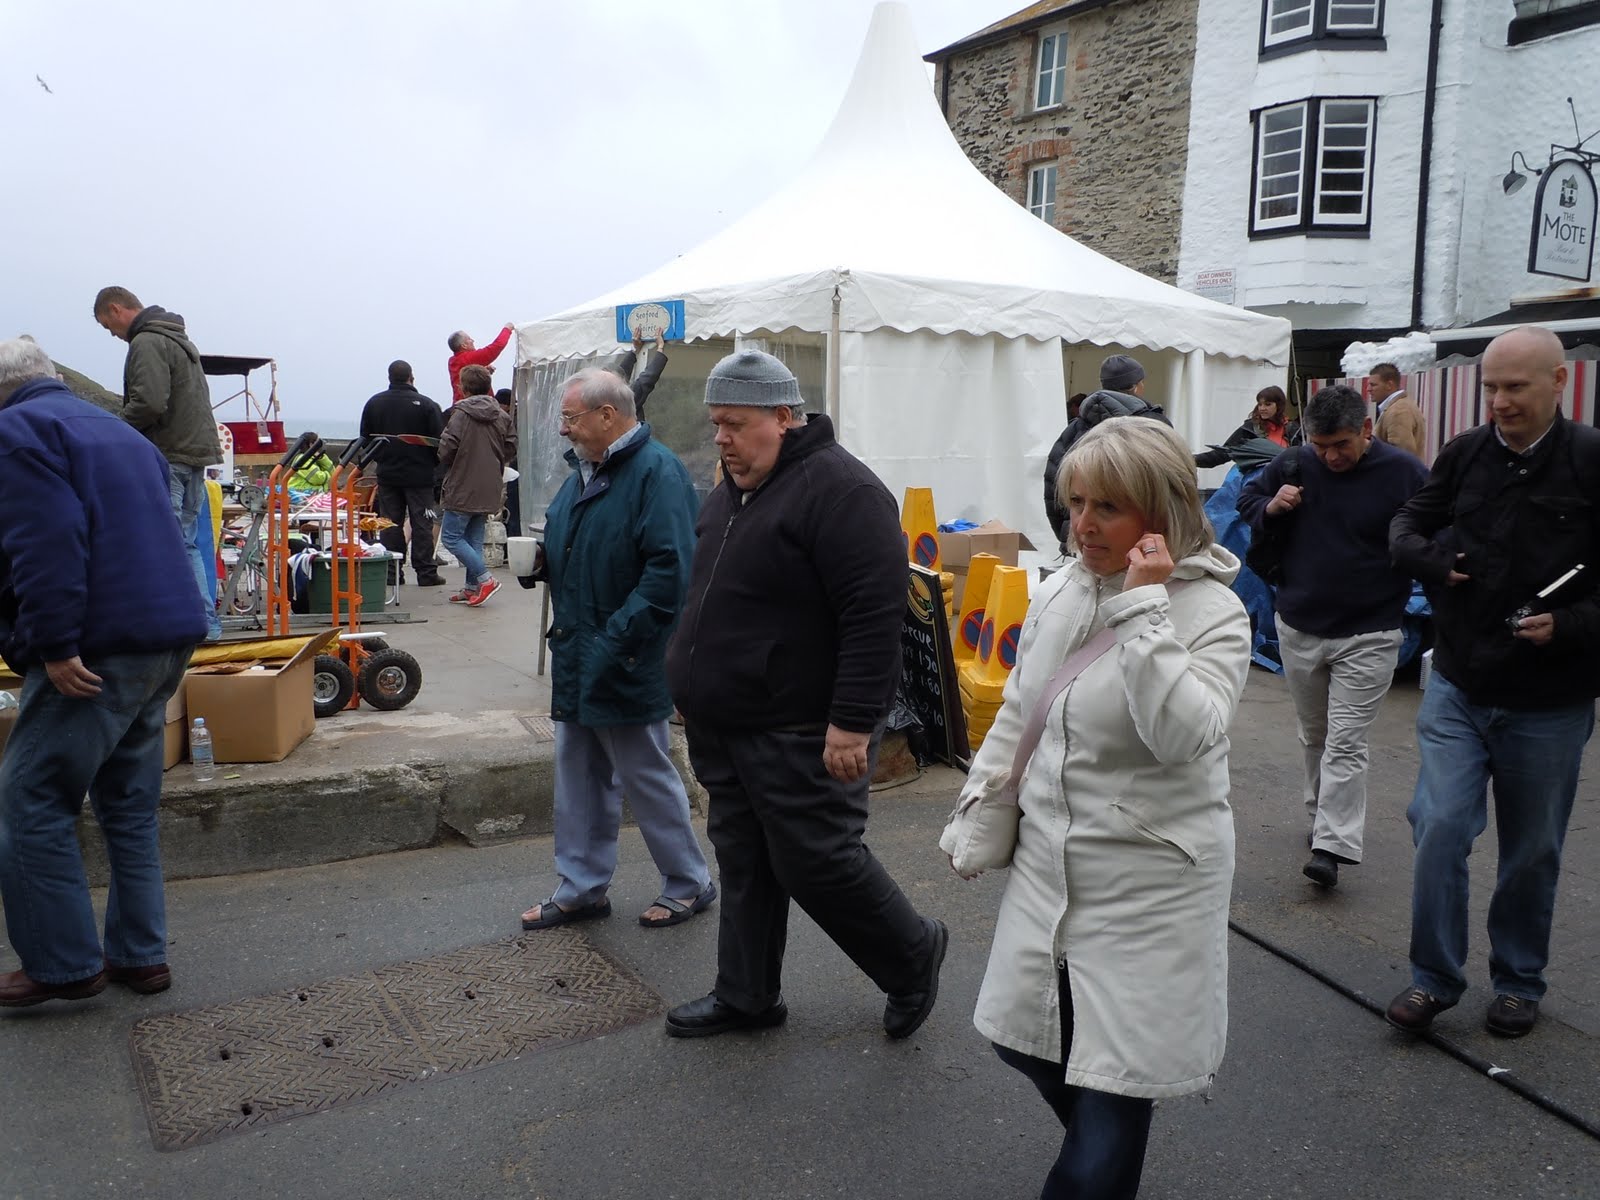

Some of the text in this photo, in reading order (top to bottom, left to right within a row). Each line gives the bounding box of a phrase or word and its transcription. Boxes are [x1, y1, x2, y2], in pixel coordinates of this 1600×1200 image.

[1563, 211, 1576, 222] THE
[1543, 213, 1587, 245] MOTE
[1211, 271, 1232, 279] OWNERS
[636, 310, 659, 323] Seafood
